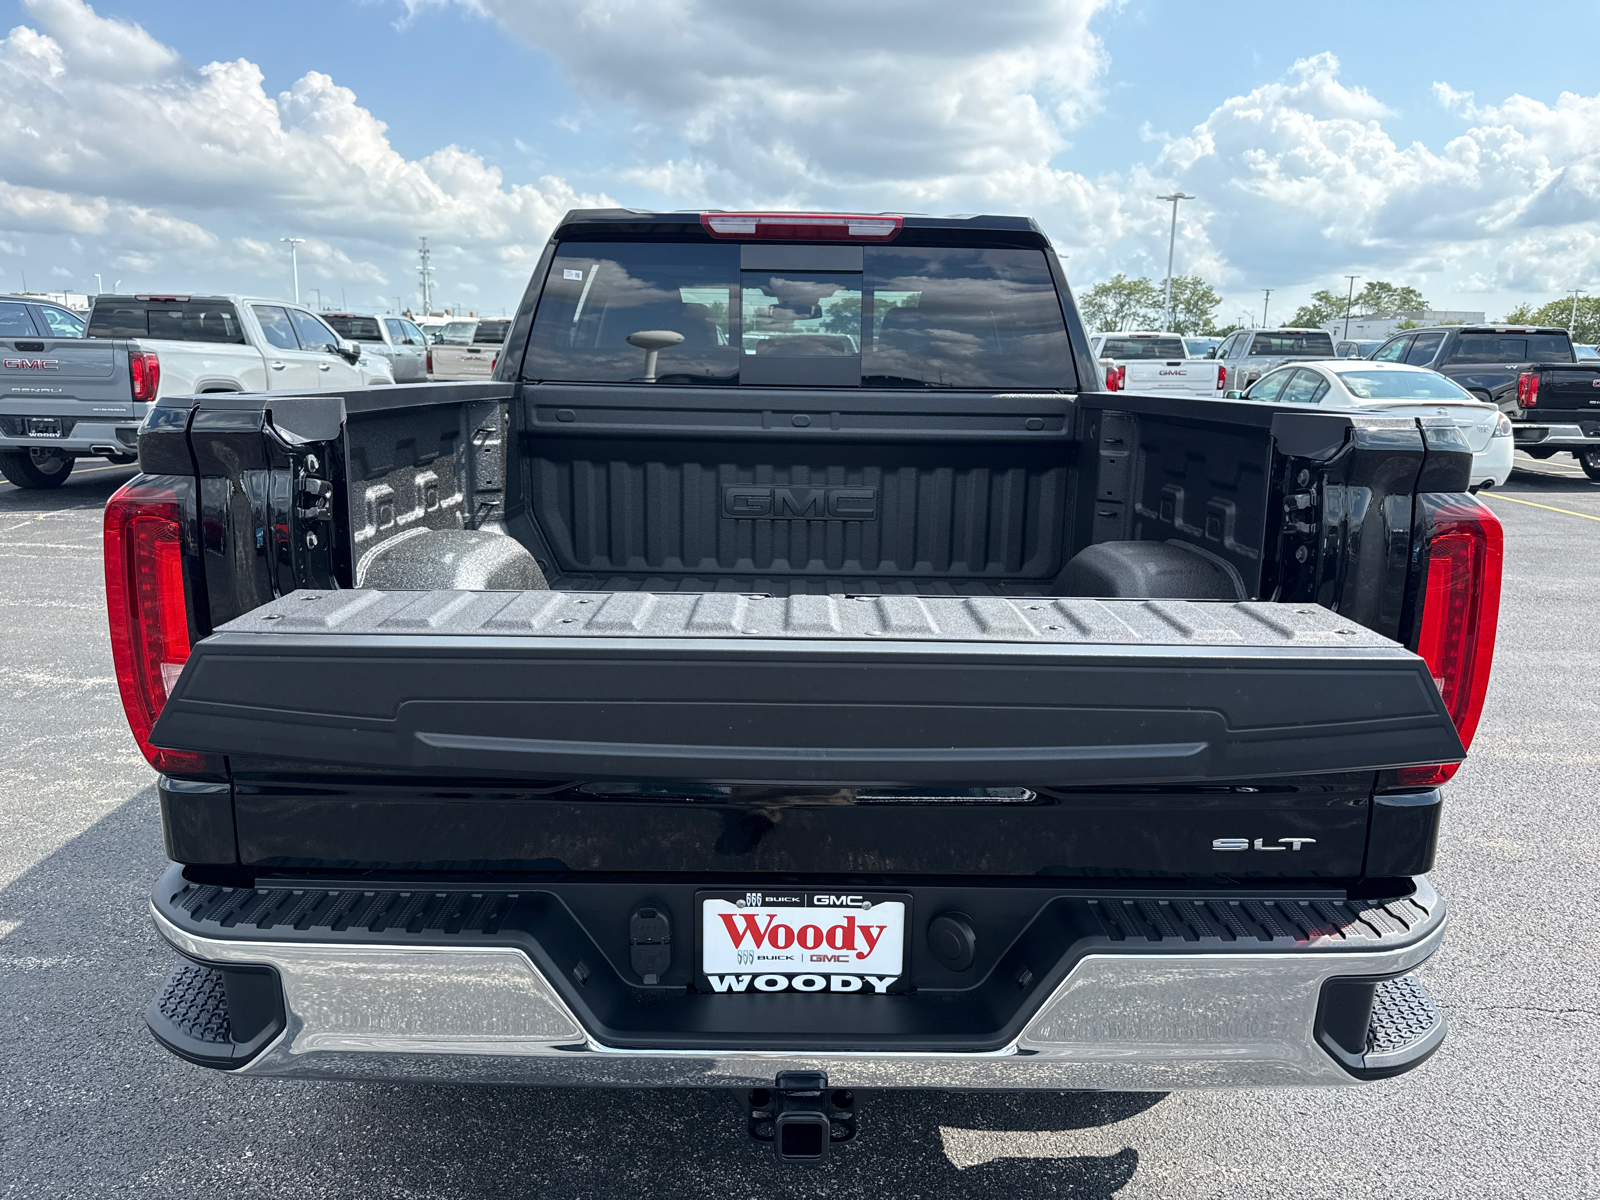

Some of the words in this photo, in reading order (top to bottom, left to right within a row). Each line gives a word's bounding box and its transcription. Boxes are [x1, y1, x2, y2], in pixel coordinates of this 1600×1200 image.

[3, 358, 59, 371] GMC
[725, 488, 875, 518] GMC
[1212, 838, 1317, 851] SLT
[813, 895, 863, 906] GMC
[717, 913, 887, 960] Woody
[809, 954, 849, 963] GMC
[707, 974, 898, 993] WOODY
